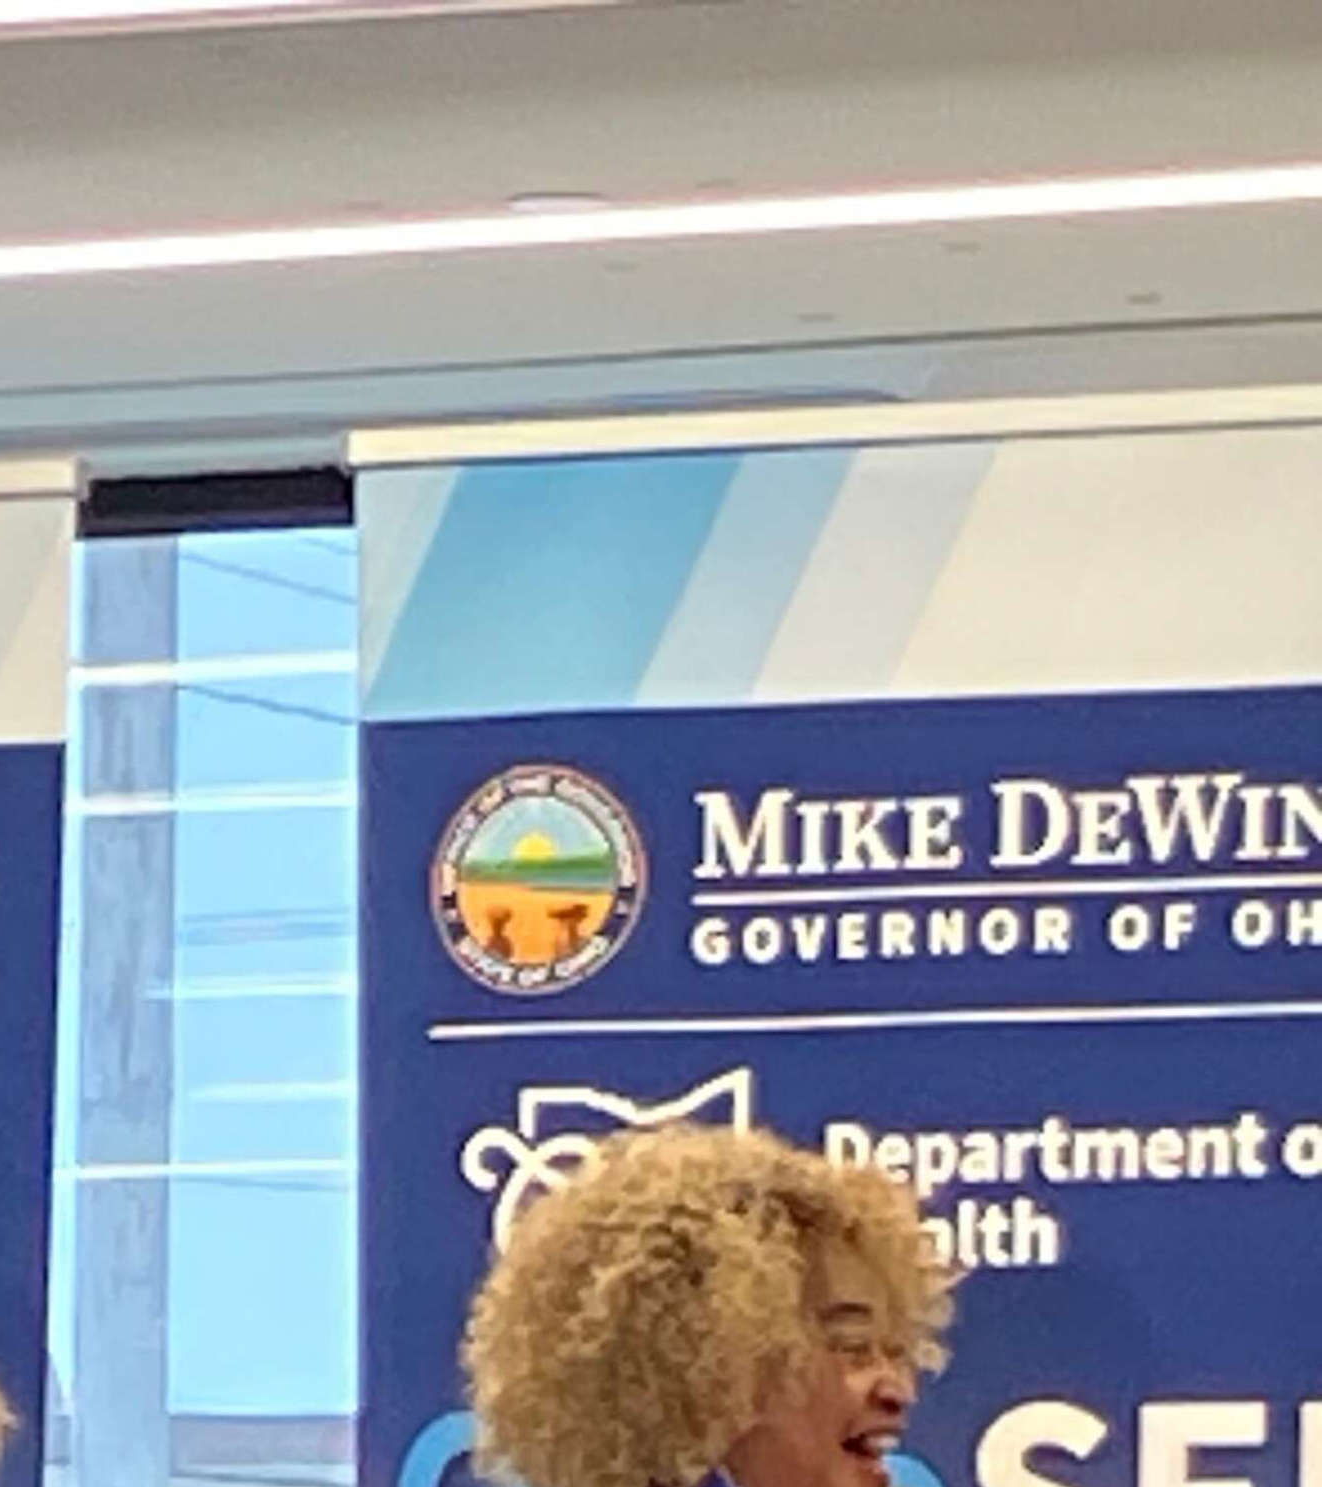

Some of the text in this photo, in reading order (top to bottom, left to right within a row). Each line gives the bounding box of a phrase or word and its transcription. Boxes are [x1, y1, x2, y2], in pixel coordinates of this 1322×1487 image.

[691, 787, 963, 879] MIKE
[689, 898, 1322, 966] GOVERNOR OF OH
[823, 1112, 1267, 1199] Department
[917, 1196, 1061, 1268] alth
